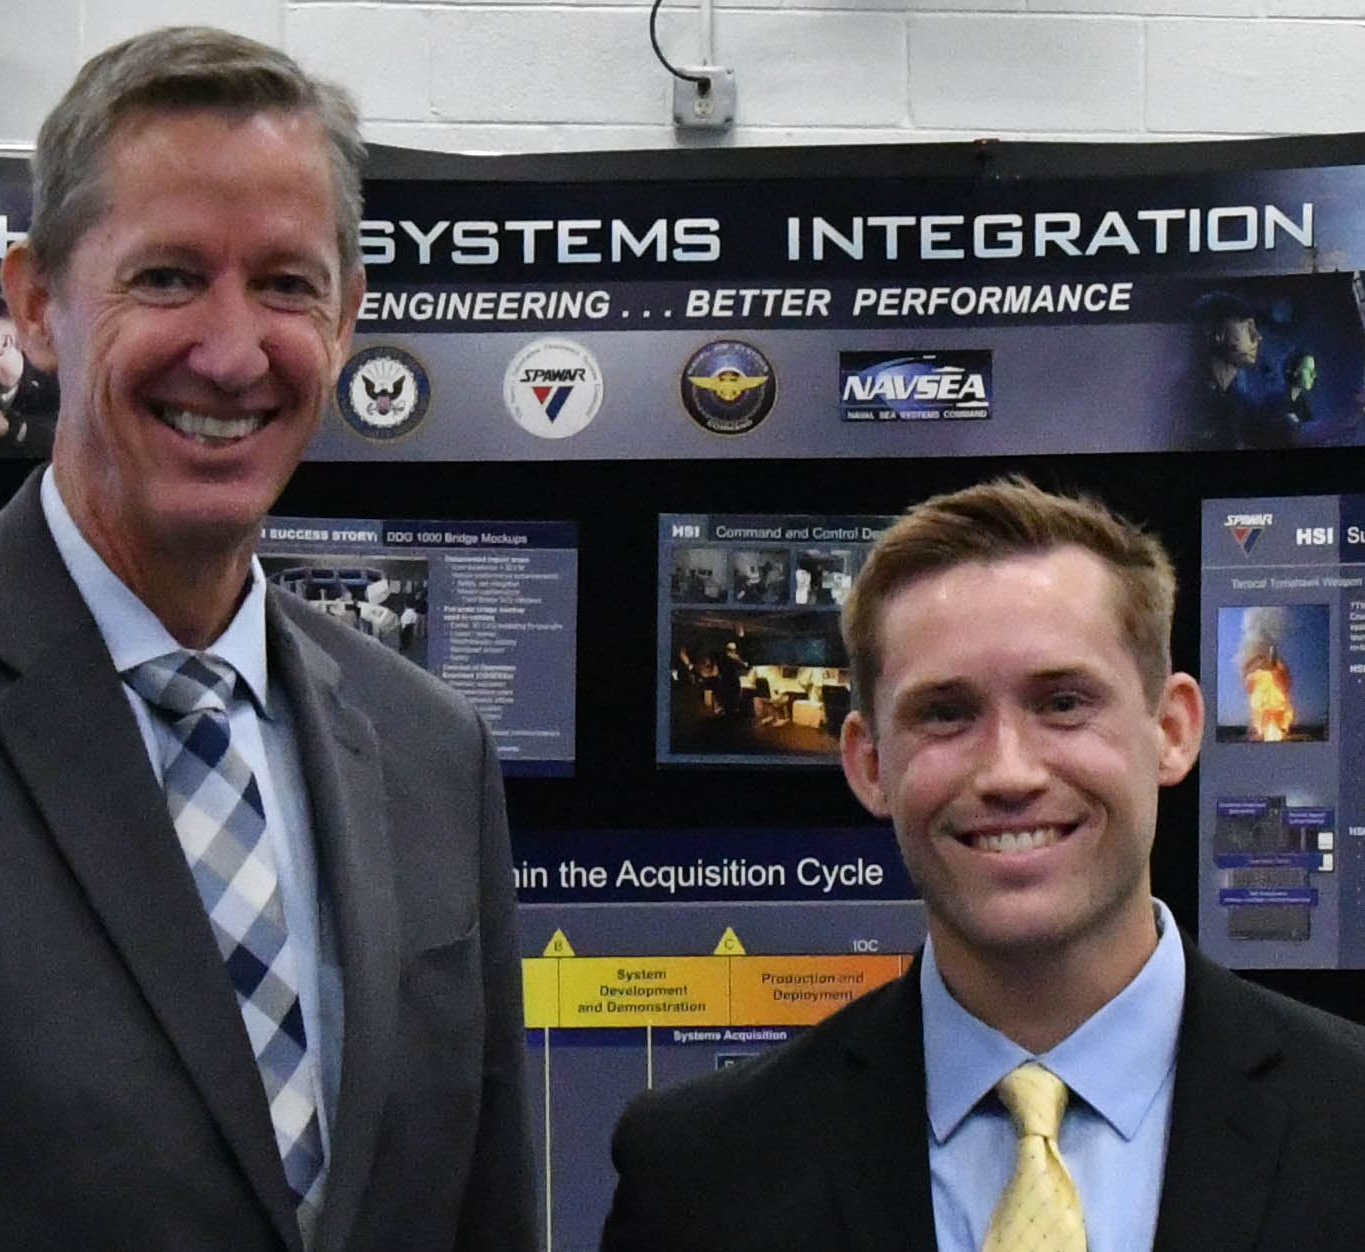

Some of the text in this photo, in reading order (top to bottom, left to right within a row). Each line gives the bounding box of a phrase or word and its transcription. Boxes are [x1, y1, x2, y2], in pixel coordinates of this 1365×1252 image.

[358, 203, 1314, 265] SYSTEMS INTEGRATION
[357, 290, 610, 320] ENGINEERING
[686, 289, 830, 318] BETTER
[852, 283, 1133, 317] PERFORMANCE
[520, 368, 586, 382] SPAWAR
[843, 374, 986, 401] NAVSEA
[269, 529, 329, 541] SUCCESS
[445, 532, 479, 545] Bridge
[481, 533, 527, 545] Mockups
[672, 525, 700, 538] HSI
[716, 525, 782, 539] Command
[785, 526, 808, 539] and
[812, 526, 858, 540] Control
[1296, 527, 1334, 545] HSI
[559, 860, 608, 888] the
[616, 858, 786, 894] Acquisition
[797, 857, 884, 893] Cycle
[853, 939, 879, 952] IOC
[617, 969, 667, 981] System
[761, 972, 864, 985] Production and
[600, 985, 688, 998] Development
[773, 989, 853, 1002] Deployment
[578, 1001, 706, 1013] and Demonstration
[673, 1030, 787, 1042] Systems Acquisition
